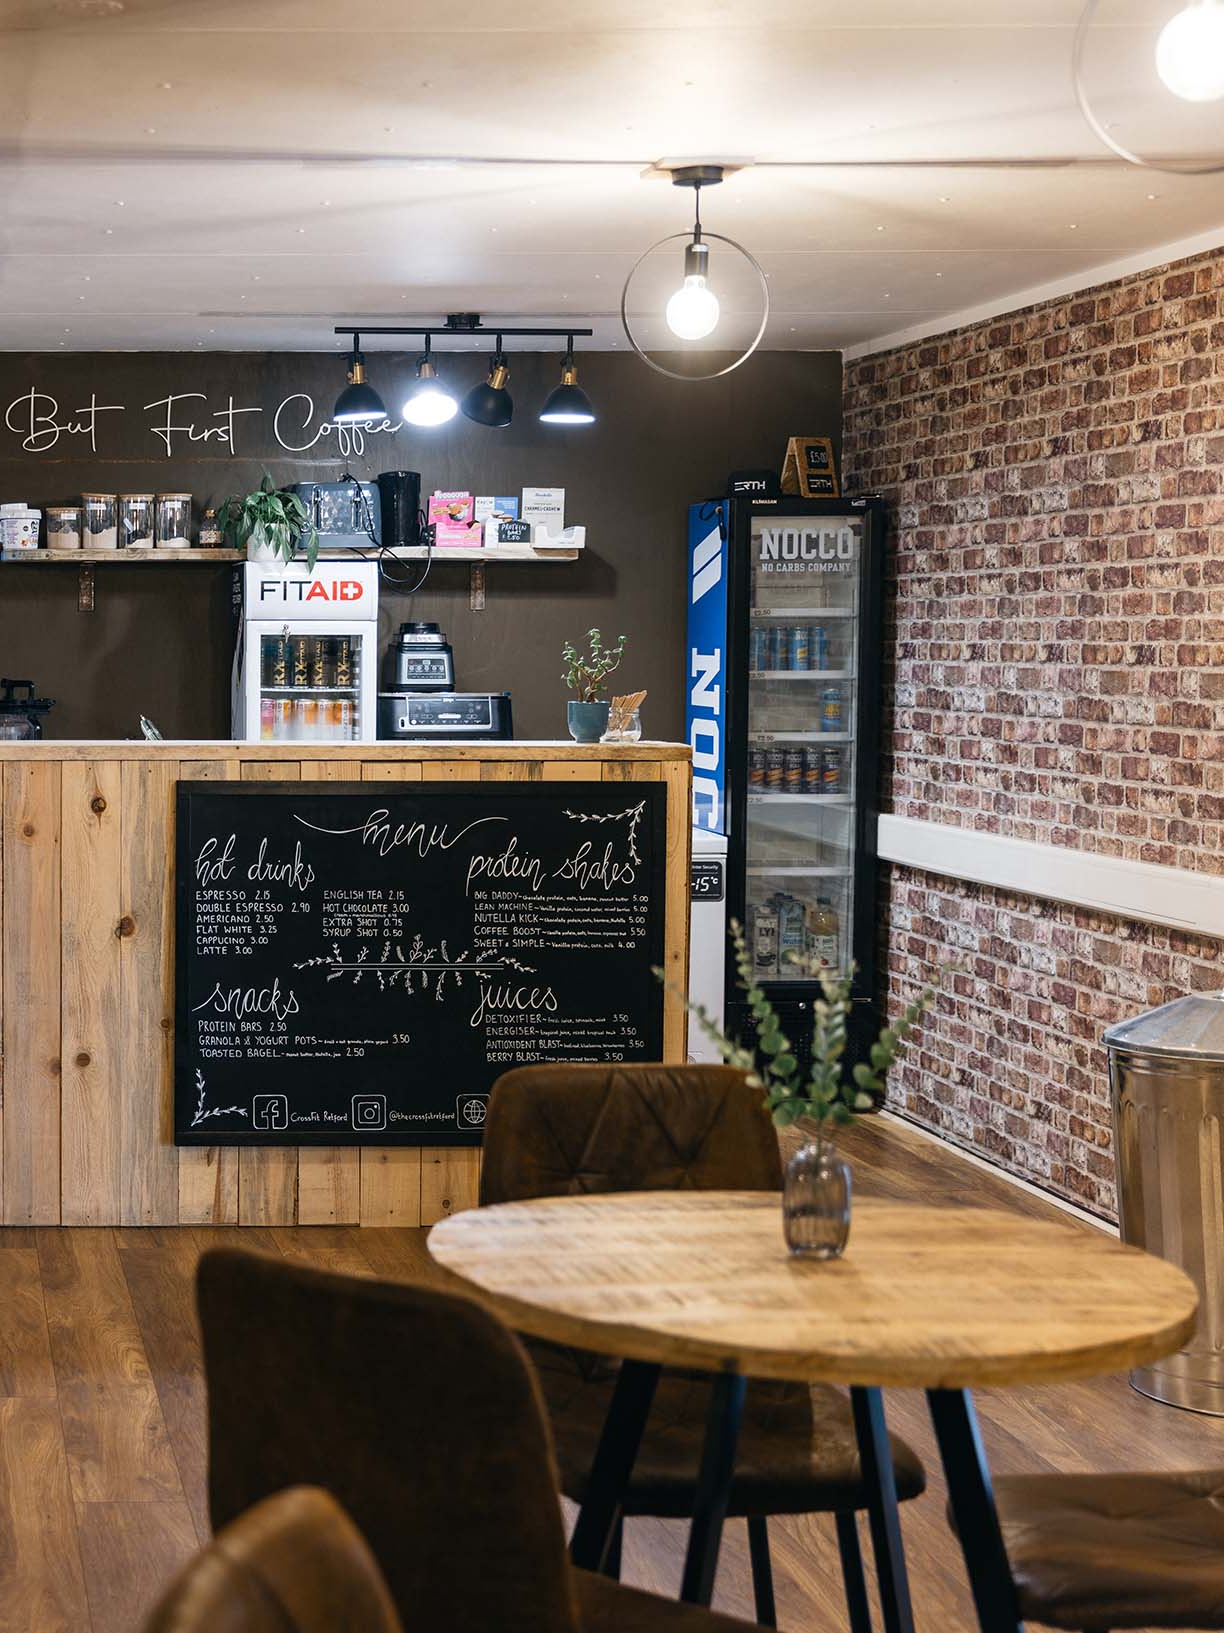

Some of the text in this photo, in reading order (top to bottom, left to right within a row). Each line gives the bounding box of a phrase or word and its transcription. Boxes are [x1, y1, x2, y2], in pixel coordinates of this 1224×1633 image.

[5, 386, 125, 452] But
[143, 393, 263, 457] First
[759, 527, 854, 560] NOCCO
[761, 562, 852, 572] NO CARBS COMPANY
[260, 580, 364, 601] FITAID
[194, 833, 315, 892] hot drinks
[465, 836, 635, 897] protein shakes
[195, 890, 271, 900] ESPRESSO 2.15
[323, 890, 405, 900] ENGLISH TEA 2.15
[474, 891, 487, 900] BIG
[632, 894, 649, 902] 5.00
[196, 902, 310, 912] DOUBLE ESPRESSO 2.90
[322, 903, 410, 913] HOT CHOCOLATE 3.00
[474, 902, 495, 910] LEAN
[196, 914, 274, 923] AMERICANO 2.50
[322, 917, 403, 926] EXTRA SHOT 0.75
[474, 913, 516, 923] NUTELLA
[628, 916, 646, 924] 5.00
[196, 925, 277, 934] FLAT WHITE 3.25
[322, 928, 403, 937] SYRUP SHOT 0.50
[473, 925, 510, 935] COFFEE
[630, 927, 646, 936] 5.50
[196, 936, 268, 944] CAPPUCINO 3.00
[473, 938, 504, 948] SWEET
[618, 940, 636, 949] 4.00
[196, 945, 253, 955] LATTE 3.00
[191, 977, 299, 1020] snacks
[470, 980, 558, 1027] juices
[612, 1014, 629, 1023] 3.50
[198, 1020, 287, 1032] PROTEIN BARS 2.50
[619, 1027, 637, 1036] 3.50
[199, 1035, 241, 1046] GRANOLA
[254, 1035, 289, 1046] YOGURT
[392, 1034, 410, 1044] 3.50
[486, 1039, 536, 1049] ANTIOXIDENT
[628, 1039, 645, 1048] 3.50
[200, 1048, 242, 1058] TOASTED
[346, 1047, 365, 1057] 2.50
[486, 1051, 513, 1062] BERRY
[604, 1052, 624, 1062] 3.50
[290, 1110, 348, 1123] CrossFit Retford
